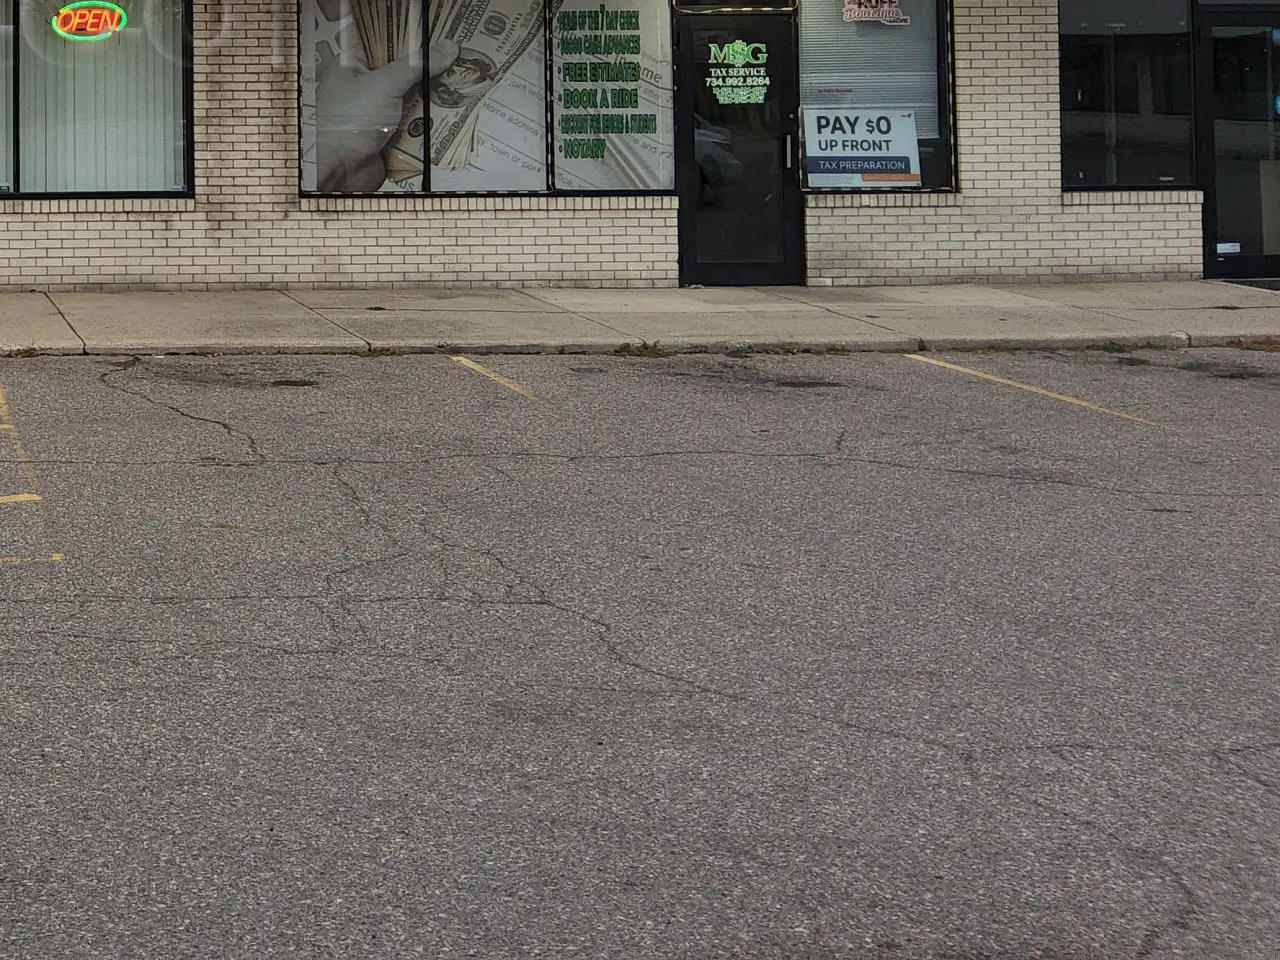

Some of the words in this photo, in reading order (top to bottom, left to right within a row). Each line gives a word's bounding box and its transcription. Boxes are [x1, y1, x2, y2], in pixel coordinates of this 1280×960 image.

[57, 9, 120, 32] OPEN
[844, 8, 901, 19] Boutique
[562, 62, 588, 82] FREE
[589, 61, 641, 82] ESTIMATES
[709, 68, 727, 77] TAX
[728, 67, 767, 76] SERVICE
[705, 77, 771, 87] 734.992.8264
[563, 88, 598, 109] BOOK
[599, 89, 609, 108] A
[610, 88, 638, 108] RIDE
[816, 115, 860, 134] PAY
[865, 115, 892, 135] $0
[563, 138, 607, 159] NOTARY
[818, 139, 838, 151] UP
[842, 139, 892, 151] FRONT
[818, 161, 837, 170] TAX
[840, 161, 905, 170] PREPARATION
